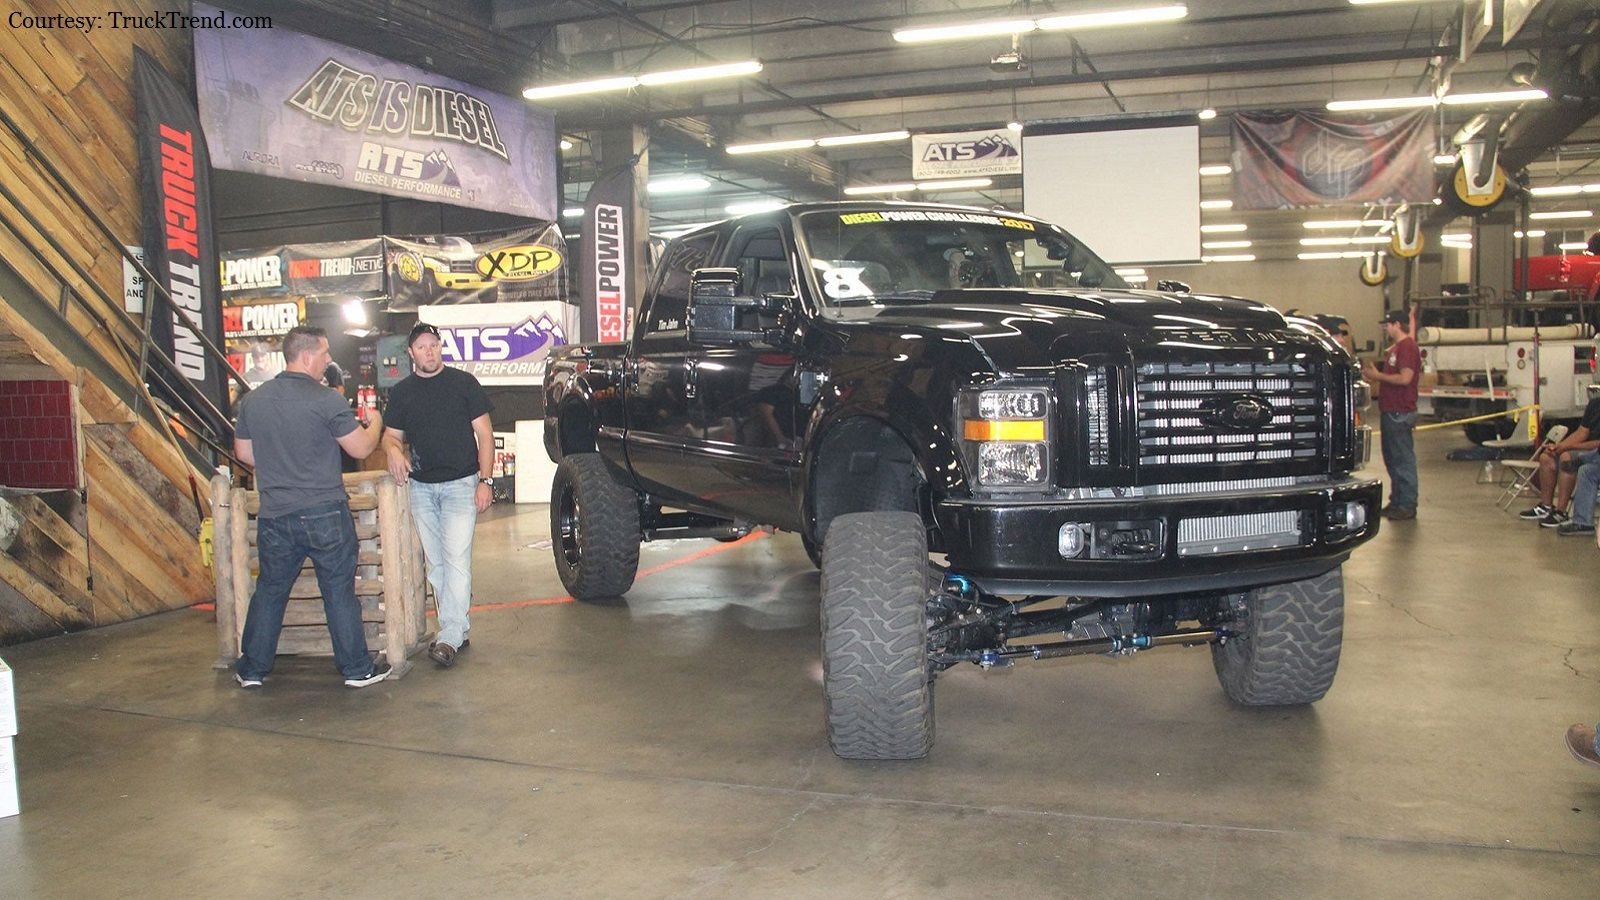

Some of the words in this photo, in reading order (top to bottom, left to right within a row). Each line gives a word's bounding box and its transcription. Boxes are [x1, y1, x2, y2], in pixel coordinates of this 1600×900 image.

[289, 60, 378, 127] ATS
[368, 80, 411, 134] IS
[411, 85, 509, 160] DIESEL
[357, 141, 425, 179] ATS
[923, 142, 977, 161] ATS
[159, 124, 199, 258] TRUCK
[354, 171, 392, 188] DIESEL
[391, 177, 462, 199] PERFORMANCE
[220, 255, 282, 286] LPOWER
[480, 250, 553, 282] XDP
[597, 206, 622, 343] ESELPOWER
[169, 261, 206, 381] TREND
[440, 328, 511, 361] ATS
[1233, 403, 1261, 420] Ford
